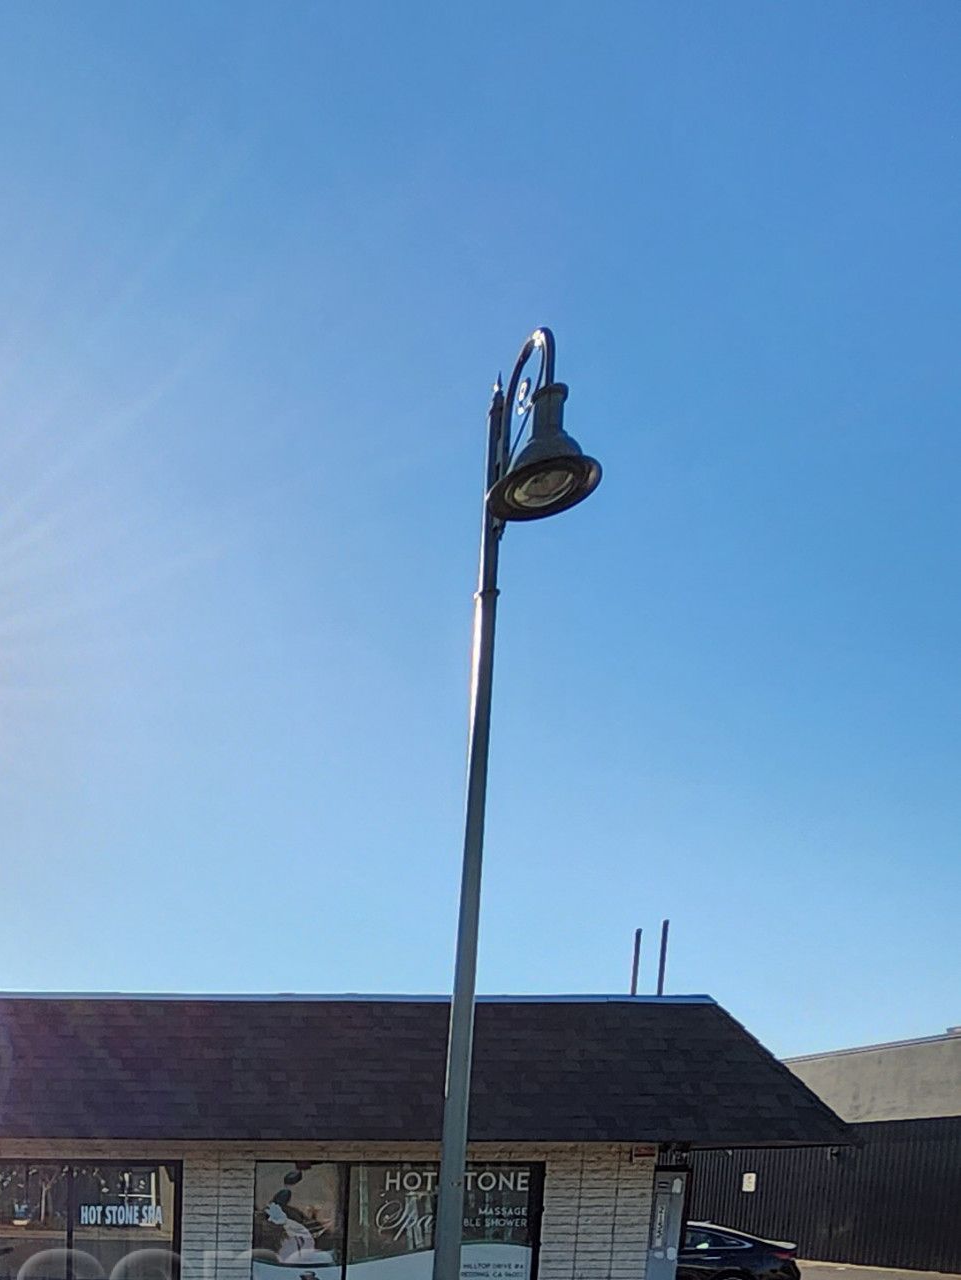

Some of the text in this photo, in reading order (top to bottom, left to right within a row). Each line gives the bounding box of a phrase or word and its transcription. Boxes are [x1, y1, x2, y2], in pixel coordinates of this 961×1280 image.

[385, 1171, 530, 1191] HOT TONE
[80, 1205, 163, 1224] HOT STONE SPA
[376, 1194, 435, 1241] Spa
[478, 1206, 528, 1216] MASSAGE
[463, 1217, 528, 1228] BLE SHOWER
